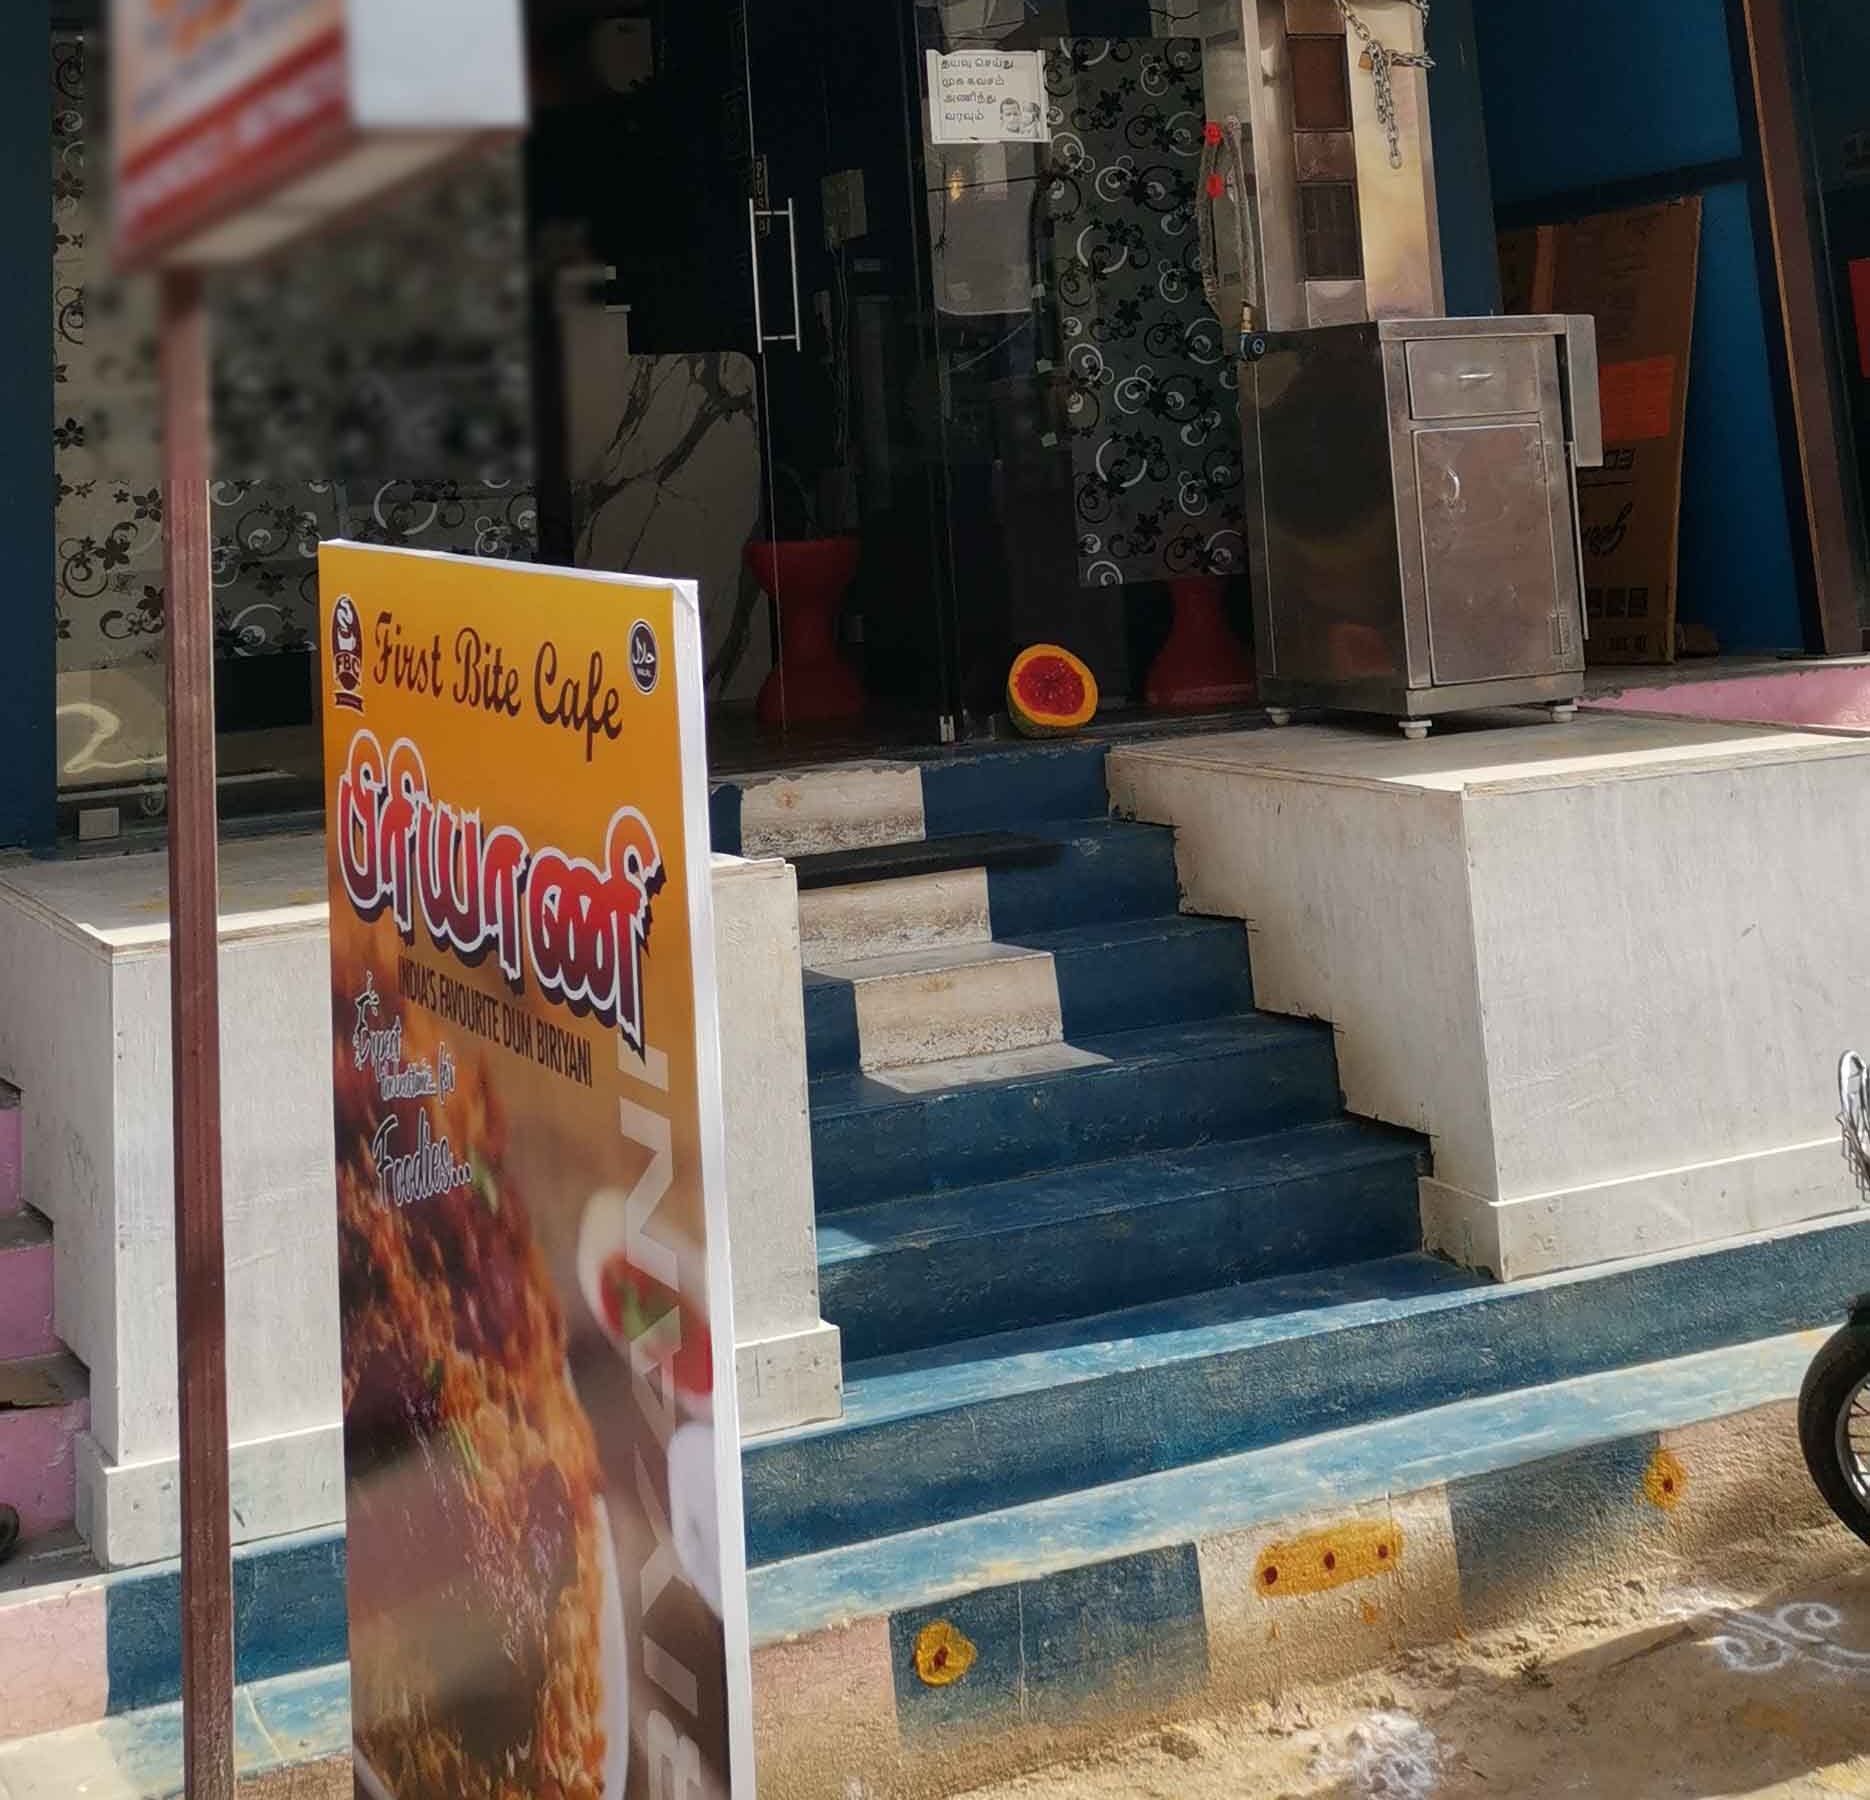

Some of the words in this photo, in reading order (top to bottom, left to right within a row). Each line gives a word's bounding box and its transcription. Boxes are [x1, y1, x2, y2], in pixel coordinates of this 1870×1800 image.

[373, 611, 443, 698] First
[453, 627, 521, 716] Bite
[534, 641, 622, 762] Cafe
[439, 973, 500, 1044] FAVOURITE
[503, 1002, 534, 1060] DUM
[537, 1018, 592, 1089] BIRIYANI
